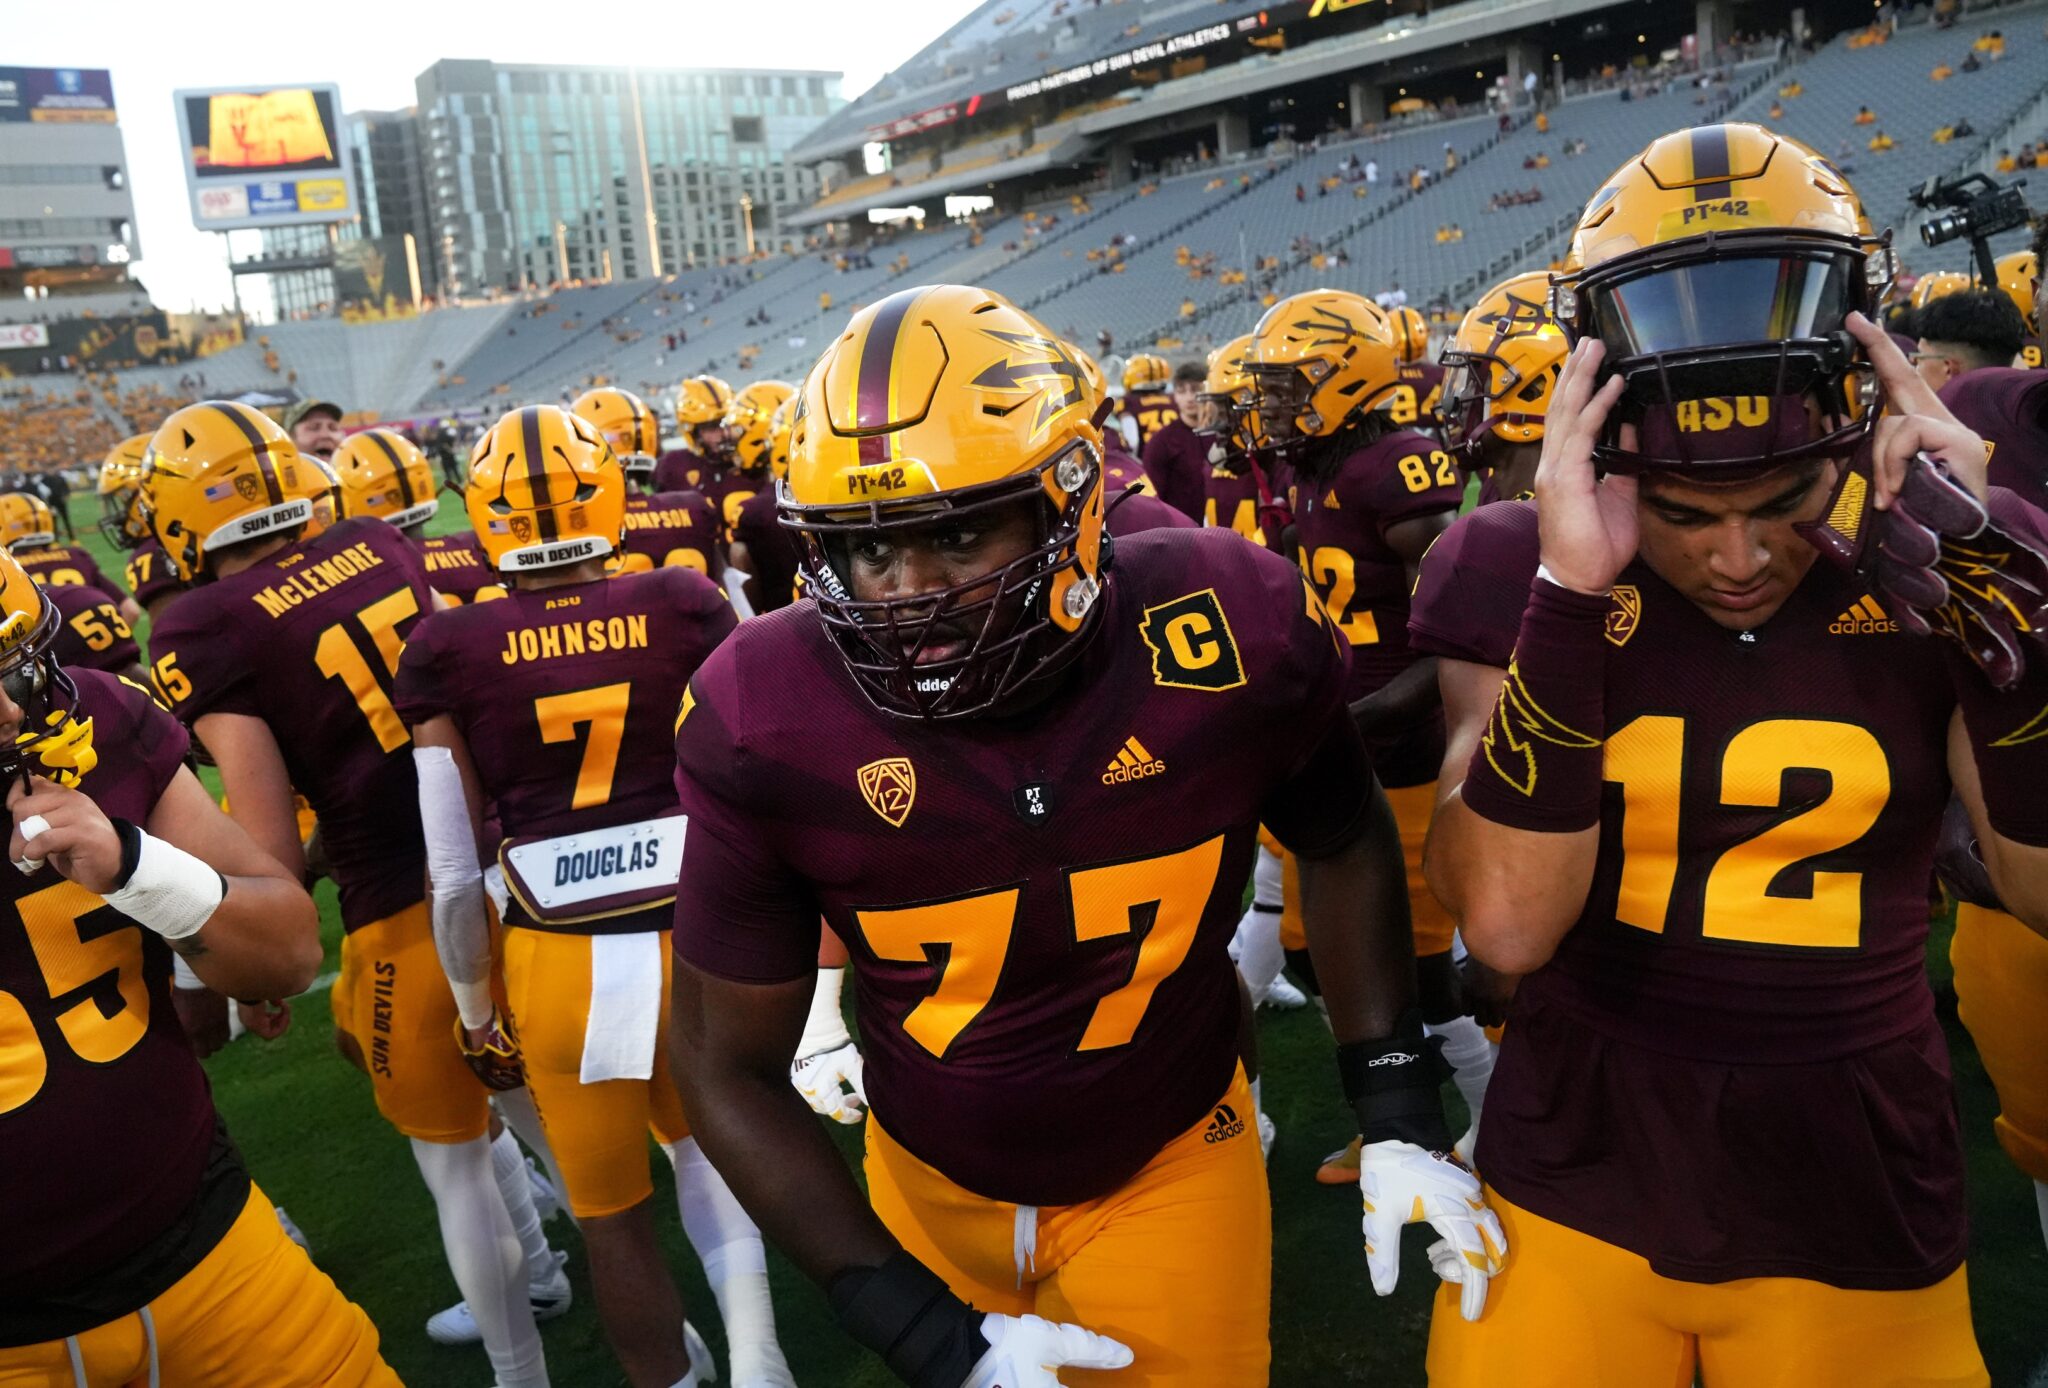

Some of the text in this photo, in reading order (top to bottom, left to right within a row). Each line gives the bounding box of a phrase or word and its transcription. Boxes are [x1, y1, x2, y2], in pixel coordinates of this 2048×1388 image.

[1006, 83, 1041, 101] PROUD
[1040, 65, 1093, 92] PARTNERS
[1092, 59, 1108, 76] OF
[1109, 53, 1133, 72] SUN
[1132, 42, 1167, 65] DEVIL
[1166, 23, 1230, 54] ATHLETICS
[1397, 450, 1456, 493] 82
[242, 504, 306, 535] SUN DEVILS
[423, 549, 479, 572] WHITE
[517, 542, 593, 566] SUN DEVILS
[545, 596, 581, 610] ASU
[1298, 545, 1380, 646] 2
[69, 604, 131, 651] 53
[502, 614, 648, 665] JOHNSON
[1164, 612, 1221, 670] C
[1738, 632, 1756, 643] 42
[1828, 619, 1899, 635] adidas
[534, 681, 631, 811] 7
[862, 763, 911, 803] PAC
[1102, 759, 1166, 785] adidas
[878, 787, 907, 814] 12
[1025, 787, 1041, 800] PT
[1029, 802, 1045, 816] 42
[1602, 714, 1891, 949] 12
[554, 838, 660, 887] DOUGLAS
[856, 833, 1226, 1059] 77
[372, 961, 396, 1079] SUN DEVILS
[1204, 1119, 1245, 1144] adidas
